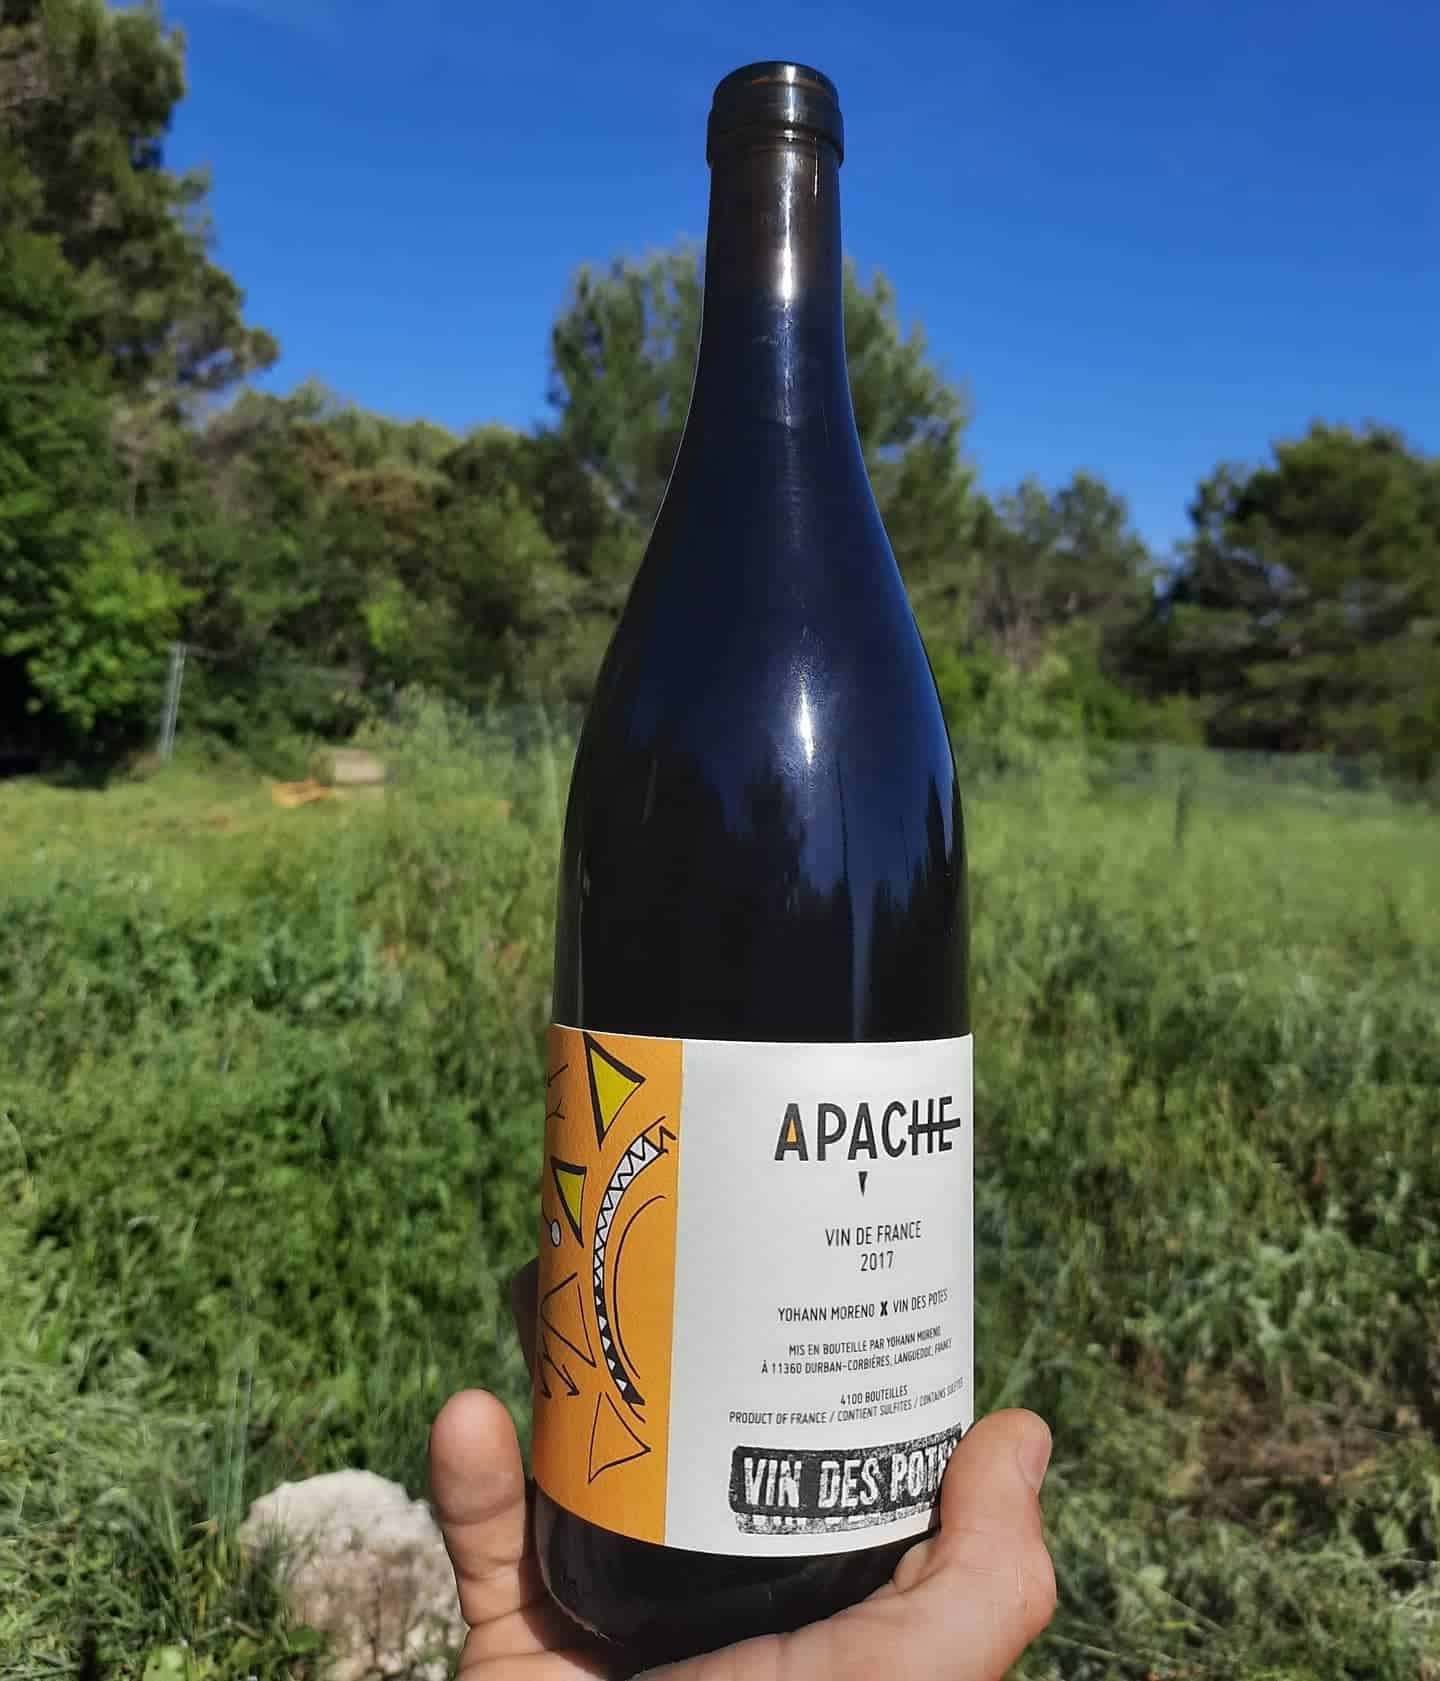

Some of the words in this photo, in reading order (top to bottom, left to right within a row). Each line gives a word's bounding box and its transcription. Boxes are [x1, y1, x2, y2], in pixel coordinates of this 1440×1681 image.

[774, 1096, 960, 1161] APACHE
[825, 1228, 850, 1246] VIN
[856, 1227, 873, 1245] DE
[877, 1221, 921, 1242] FRANCE
[860, 1251, 894, 1271] 2017
[777, 1306, 827, 1322] YOHANN
[831, 1303, 875, 1320] MORENO
[880, 1300, 888, 1317] X
[893, 1298, 909, 1313] VIN
[911, 1295, 926, 1311] DES
[928, 1288, 949, 1306] POTES
[788, 1344, 805, 1356] MIS
[807, 1343, 820, 1355] EN
[823, 1339, 867, 1355] BOUTEILLE
[870, 1337, 885, 1351] PAR
[886, 1332, 916, 1348] YOHANN
[761, 1359, 768, 1374] À
[772, 1362, 802, 1374] 11360
[840, 1393, 863, 1405] 4100
[865, 1384, 908, 1403] BOUTEILLES
[729, 1411, 772, 1424] PRODUCT
[776, 1413, 788, 1424] OF
[790, 1411, 827, 1424] FRANCE
[829, 1411, 835, 1423] /
[837, 1406, 877, 1422] CONTIENT
[879, 1399, 912, 1416] SULFITES
[743, 1457, 802, 1508] VIN
[818, 1457, 880, 1508] DES
